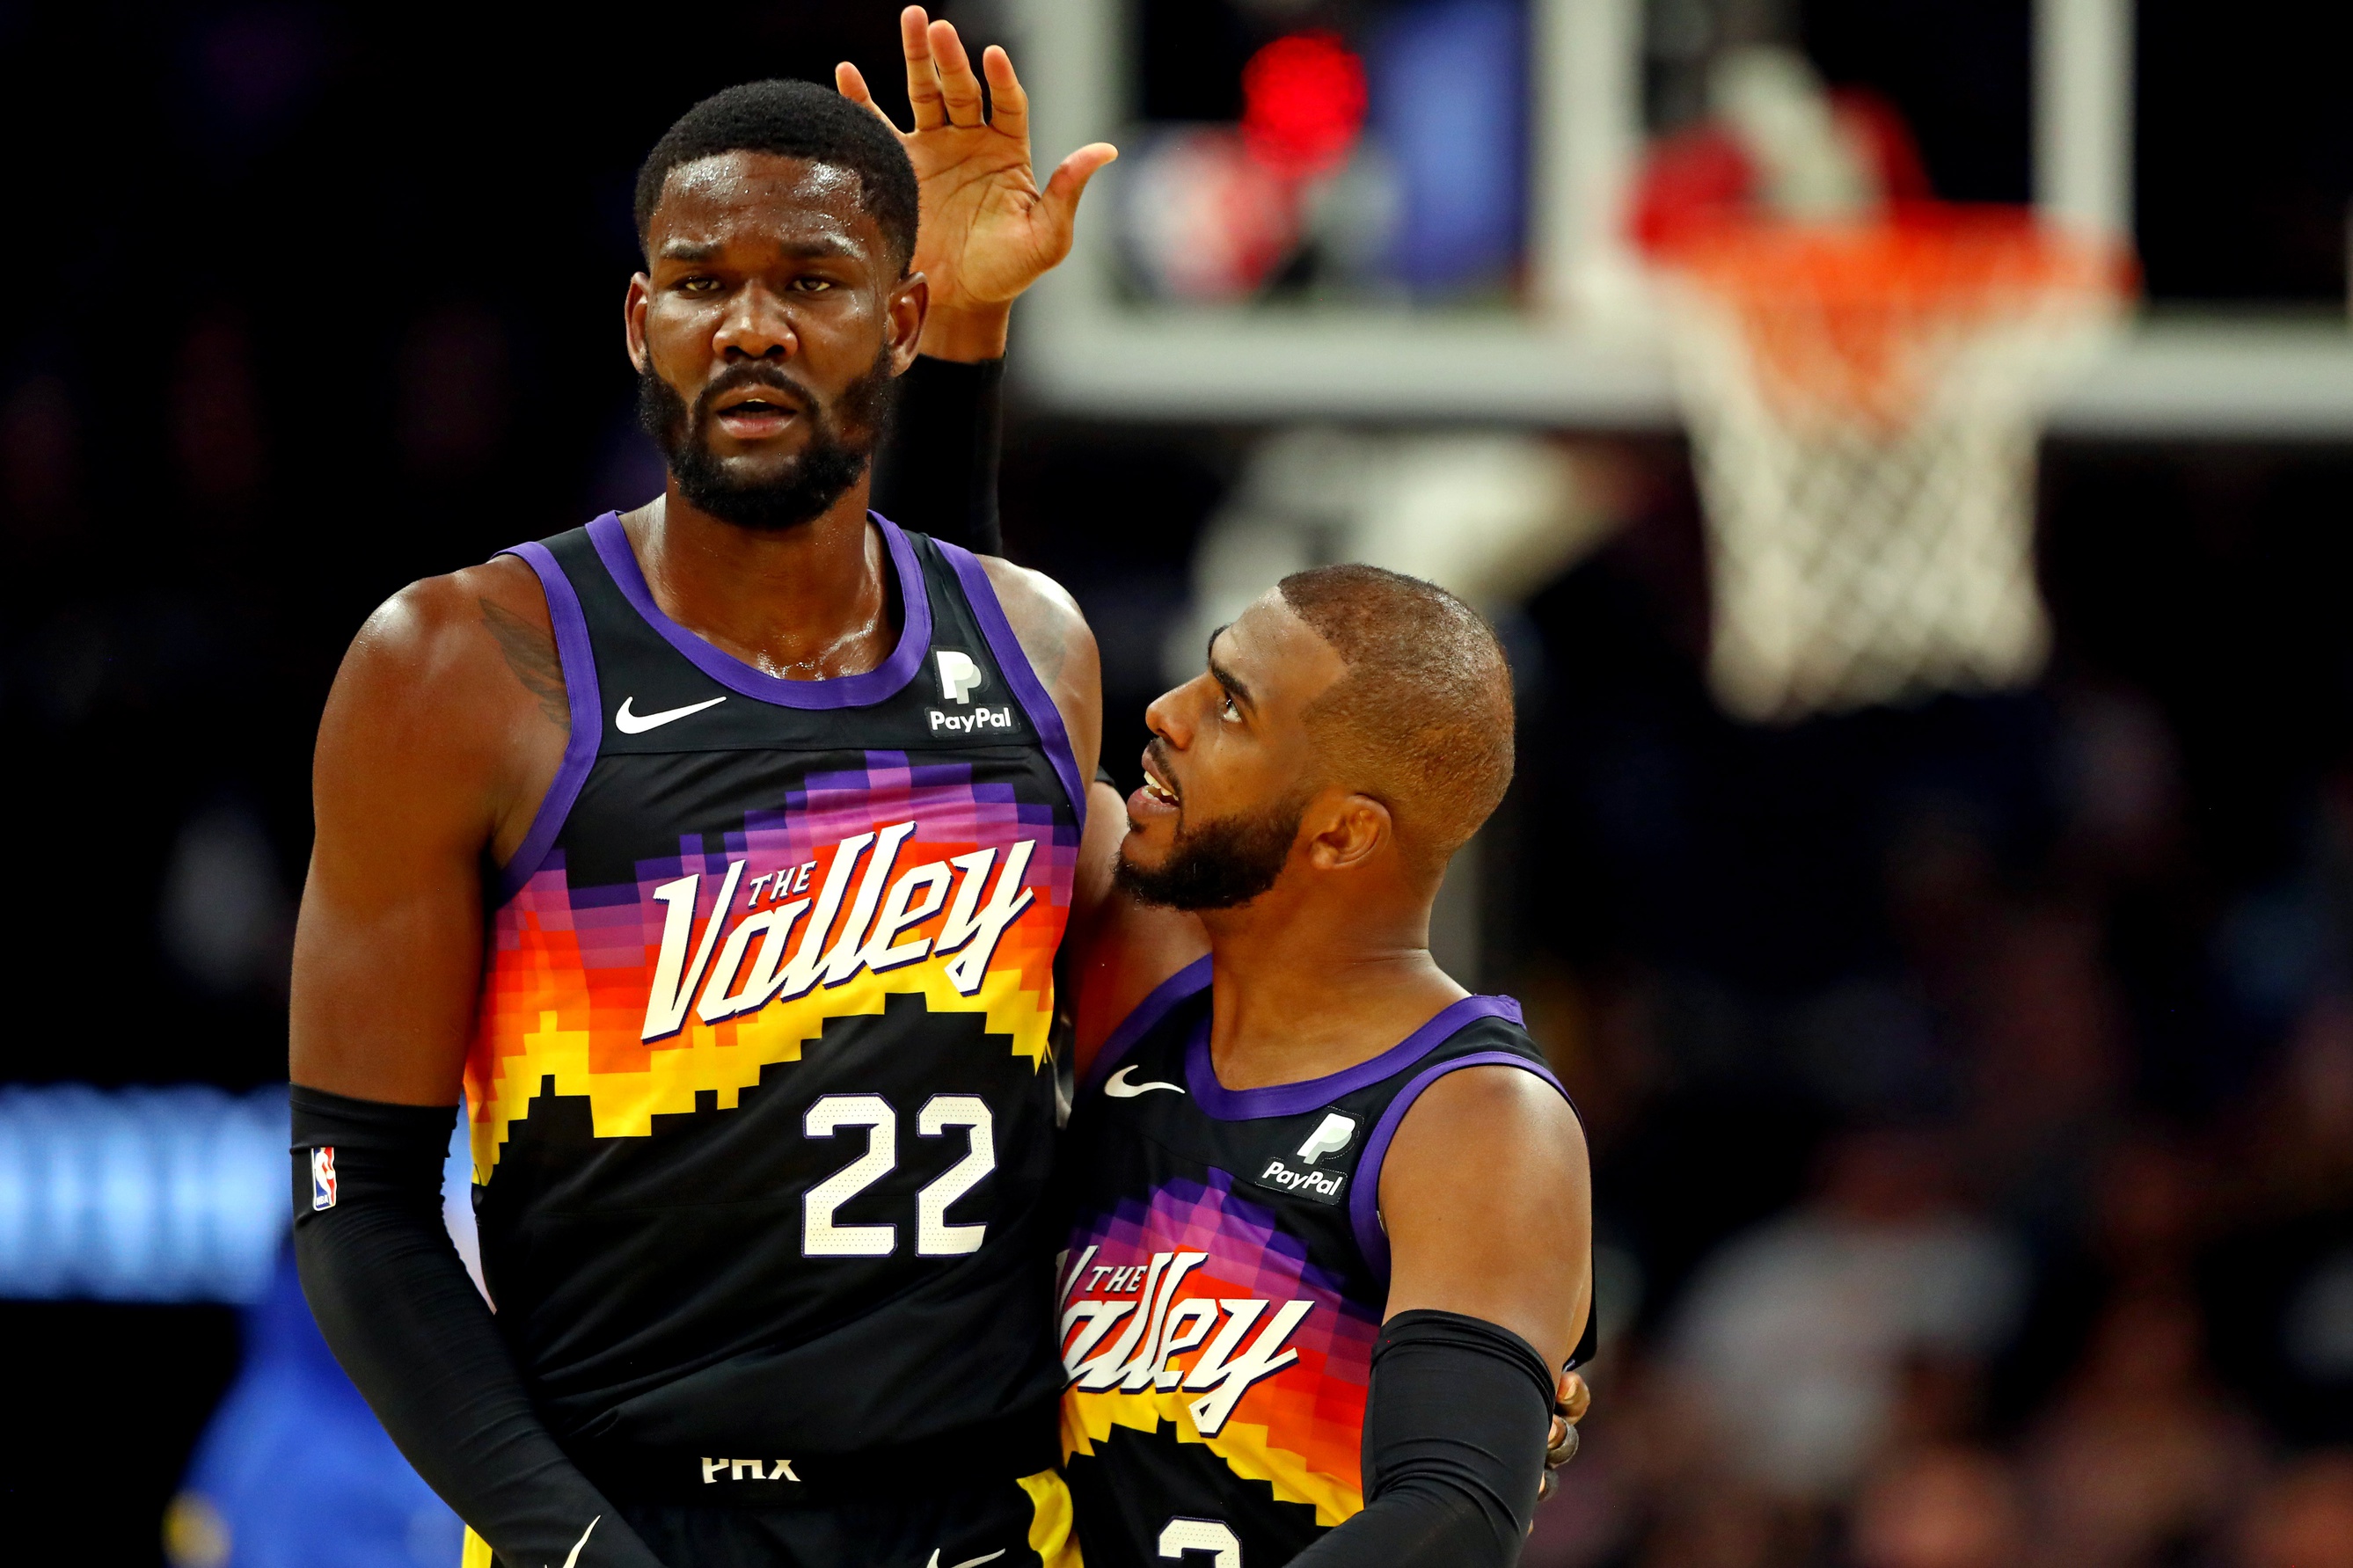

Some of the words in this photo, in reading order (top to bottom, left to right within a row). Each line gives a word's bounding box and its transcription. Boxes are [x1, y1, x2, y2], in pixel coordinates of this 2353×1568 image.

[930, 707, 1012, 733] PayPal
[748, 860, 818, 908] THE
[640, 820, 1036, 1045] Valley
[801, 1092, 998, 1258] 22
[1261, 1161, 1343, 1196] PayPal
[317, 1194, 328, 1206] NBA
[1085, 1265, 1149, 1293] THE
